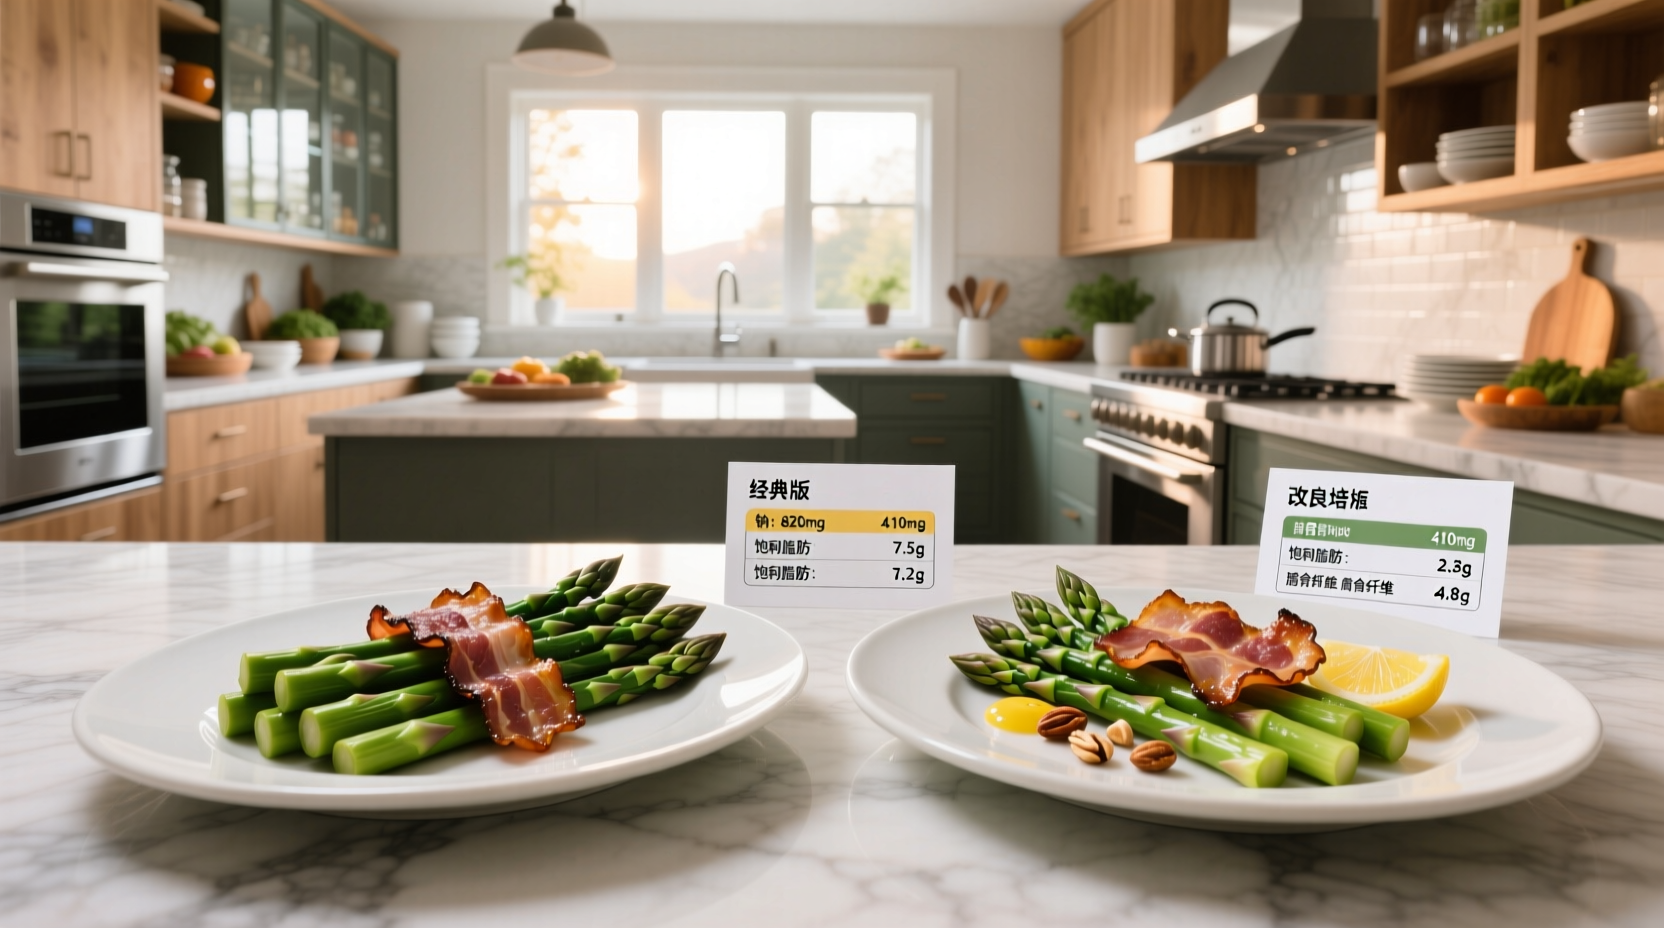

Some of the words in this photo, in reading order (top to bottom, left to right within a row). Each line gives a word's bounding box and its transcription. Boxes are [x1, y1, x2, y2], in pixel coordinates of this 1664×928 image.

[749, 479, 810, 500] 经典版
[780, 516, 825, 532] 820mg
[881, 517, 926, 532] 410mg
[892, 541, 925, 558] 7.5g
[1431, 531, 1476, 550] 410mg
[892, 568, 925, 584] 7.2g
[1434, 586, 1470, 605] 4.8g
